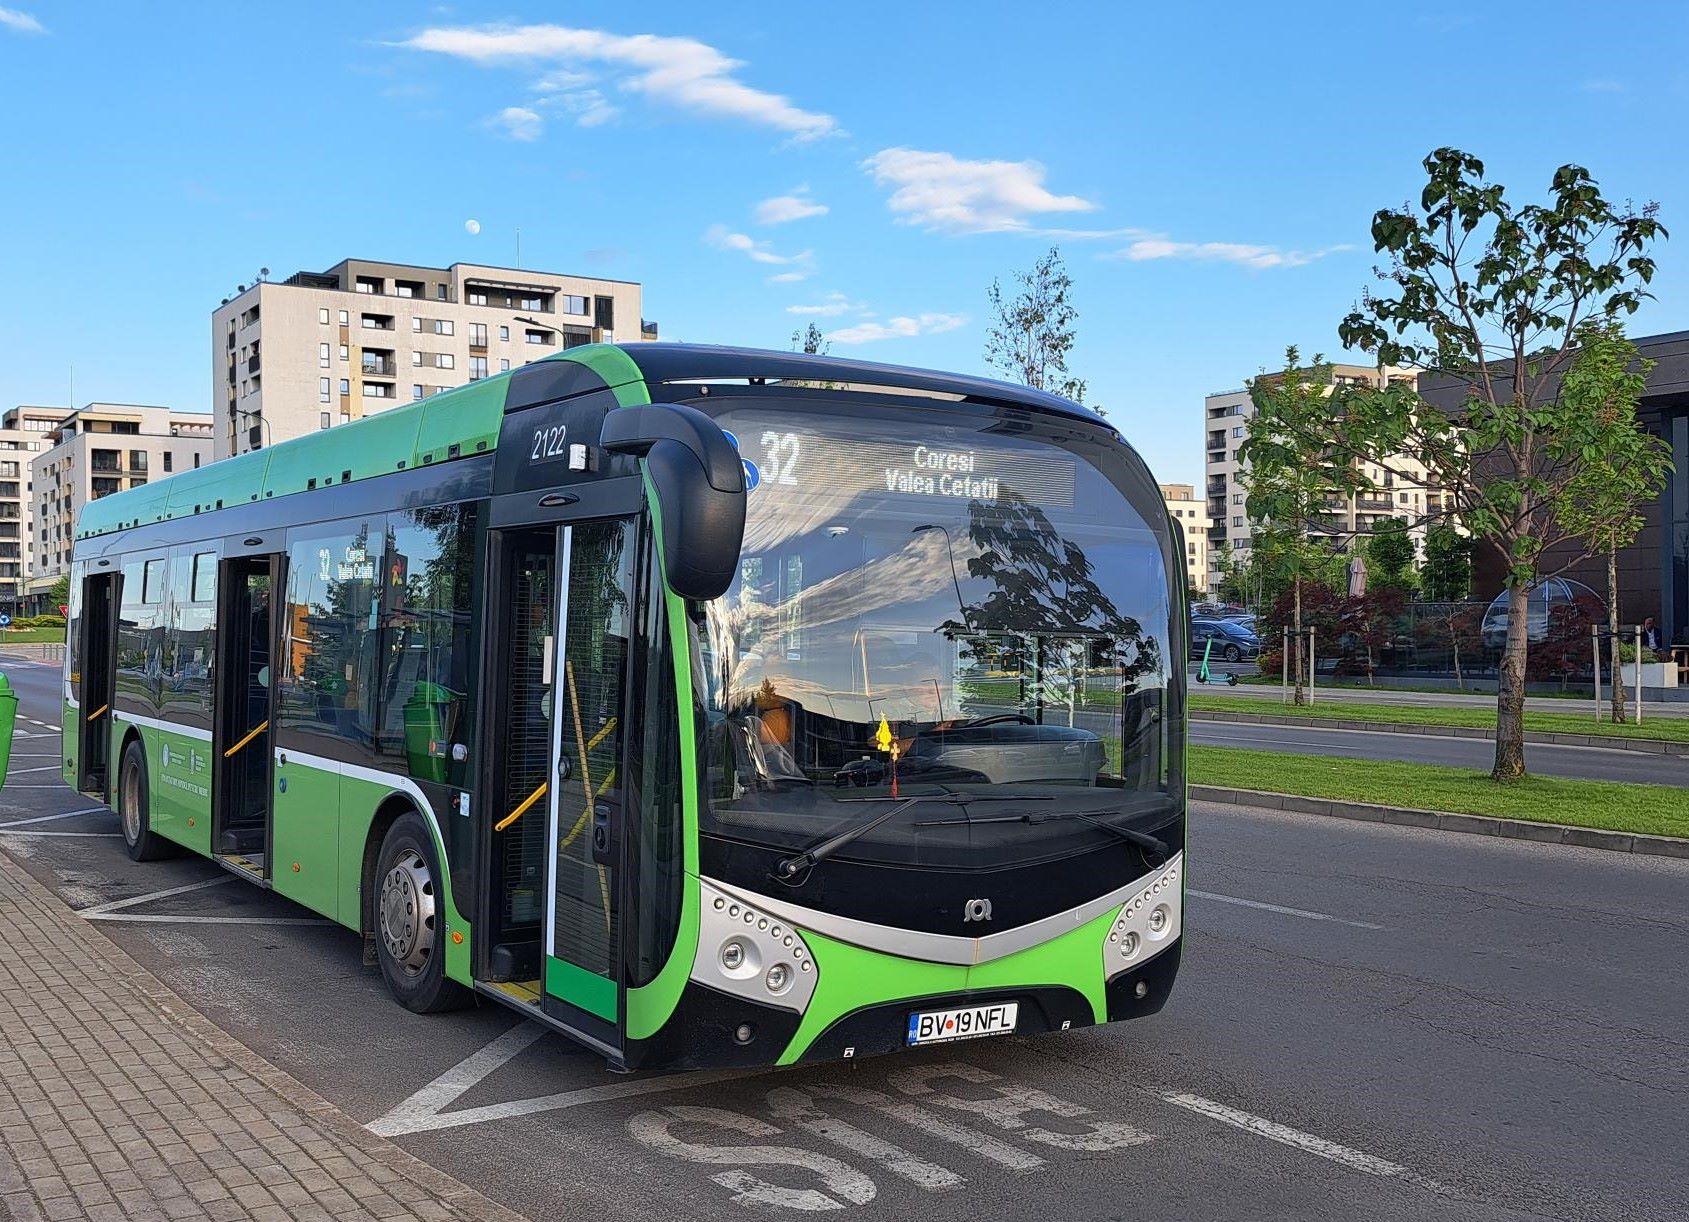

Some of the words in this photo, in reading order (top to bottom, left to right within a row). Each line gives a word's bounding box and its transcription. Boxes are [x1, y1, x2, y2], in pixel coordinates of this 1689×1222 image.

[532, 425, 566, 459] 2122
[760, 431, 800, 485] 32
[914, 446, 974, 472] Coresi
[885, 469, 935, 494] Valea
[920, 1015, 948, 1037] BV
[955, 1012, 972, 1033] 19
[975, 1007, 1011, 1031] NFL
